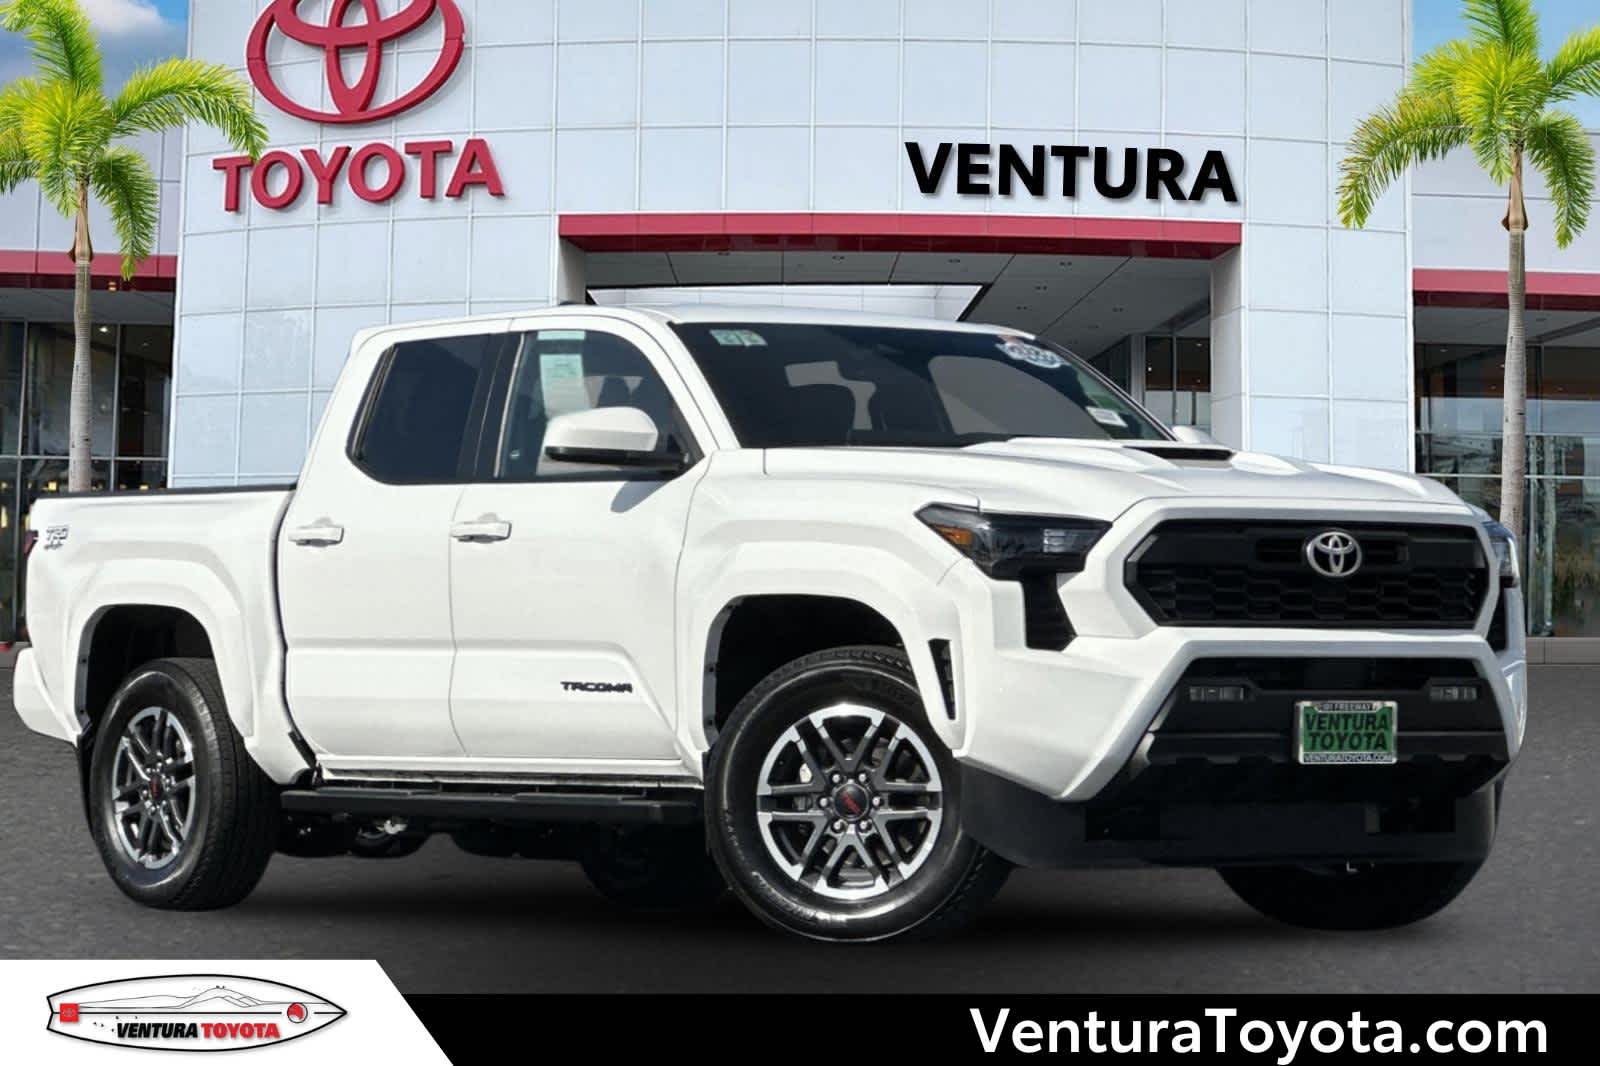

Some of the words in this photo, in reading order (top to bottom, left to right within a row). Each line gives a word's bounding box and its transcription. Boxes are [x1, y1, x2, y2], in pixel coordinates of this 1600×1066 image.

[213, 139, 504, 212] TOYOTA
[905, 142, 1238, 202] VENTURA
[561, 681, 633, 693] TACOMA
[1304, 713, 1389, 730] VENTURA
[1309, 731, 1388, 750] TOYOTA
